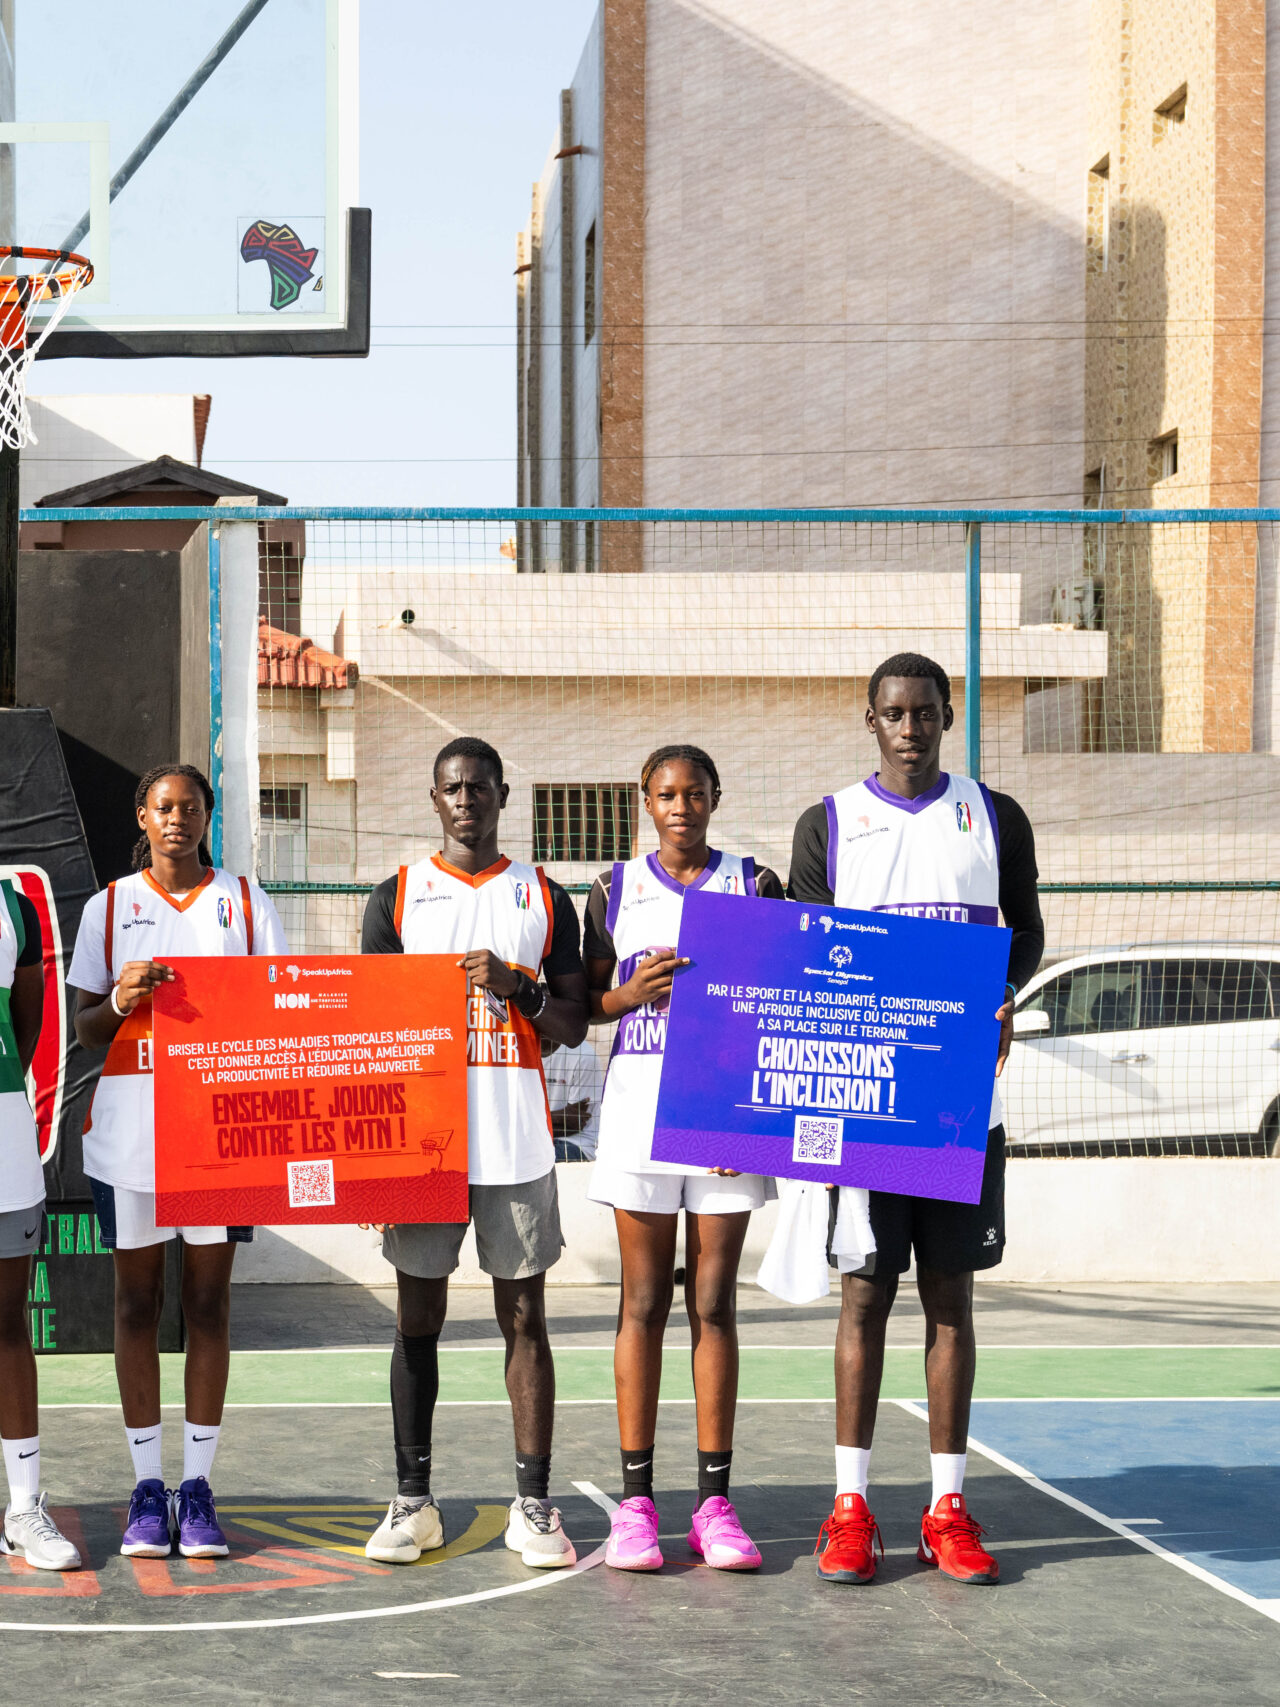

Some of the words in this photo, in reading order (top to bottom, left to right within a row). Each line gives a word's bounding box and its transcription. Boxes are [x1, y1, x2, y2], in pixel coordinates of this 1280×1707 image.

[274, 993, 310, 1009] NON
[707, 984, 728, 998] PAR
[730, 985, 744, 999] LE
[745, 987, 781, 1001] SPORT
[783, 989, 797, 1002] ET
[799, 990, 812, 1003] LA
[814, 991, 878, 1009] SOLIDARITÉ,
[880, 996, 965, 1014] CONSTRUISONS
[732, 1000, 755, 1014] UNE
[757, 1002, 802, 1018] AFRIQUE
[806, 1006, 862, 1021] INCLUSIVE
[863, 1007, 880, 1023] OÙ
[167, 1042, 204, 1057] BRISER
[207, 1040, 220, 1054] LE
[221, 1038, 253, 1053] CYCLE
[256, 1037, 276, 1051] DES
[278, 1034, 330, 1050] MALADIES
[332, 1031, 394, 1047] TROPICALES
[395, 1026, 454, 1043] NÉGLIGÉES,
[757, 1018, 766, 1030] A
[767, 1018, 781, 1031] SA
[783, 1020, 817, 1034] PLACE
[819, 1022, 842, 1036] SUR
[845, 1024, 858, 1037] LE
[859, 1025, 909, 1040] TERRAIN.
[187, 1056, 216, 1071] C'EST
[218, 1053, 262, 1069] DONNER
[263, 1049, 297, 1066] ACCÈS
[298, 1048, 307, 1063] À
[308, 1045, 375, 1063] L'ÉDUCATION,
[376, 1042, 435, 1059] AMÉLIORER
[202, 1071, 214, 1084] LA
[216, 1065, 290, 1083] PRODUCTIVITÉ
[292, 1065, 305, 1079] ET
[307, 1061, 352, 1078] RÉDUIRE
[353, 1062, 367, 1075] LA
[369, 1059, 423, 1074] PAUVRETÉ.
[757, 1036, 896, 1079] CHOISISSONS
[212, 1088, 321, 1126] ENSEMBLE,
[328, 1082, 407, 1118] JOUONS
[751, 1070, 882, 1112] L'INCLUSION
[887, 1081, 896, 1113] !
[217, 1124, 295, 1159] CONTRE
[302, 1121, 336, 1154] LES
[343, 1118, 392, 1151] MTN
[399, 1117, 407, 1148] !
